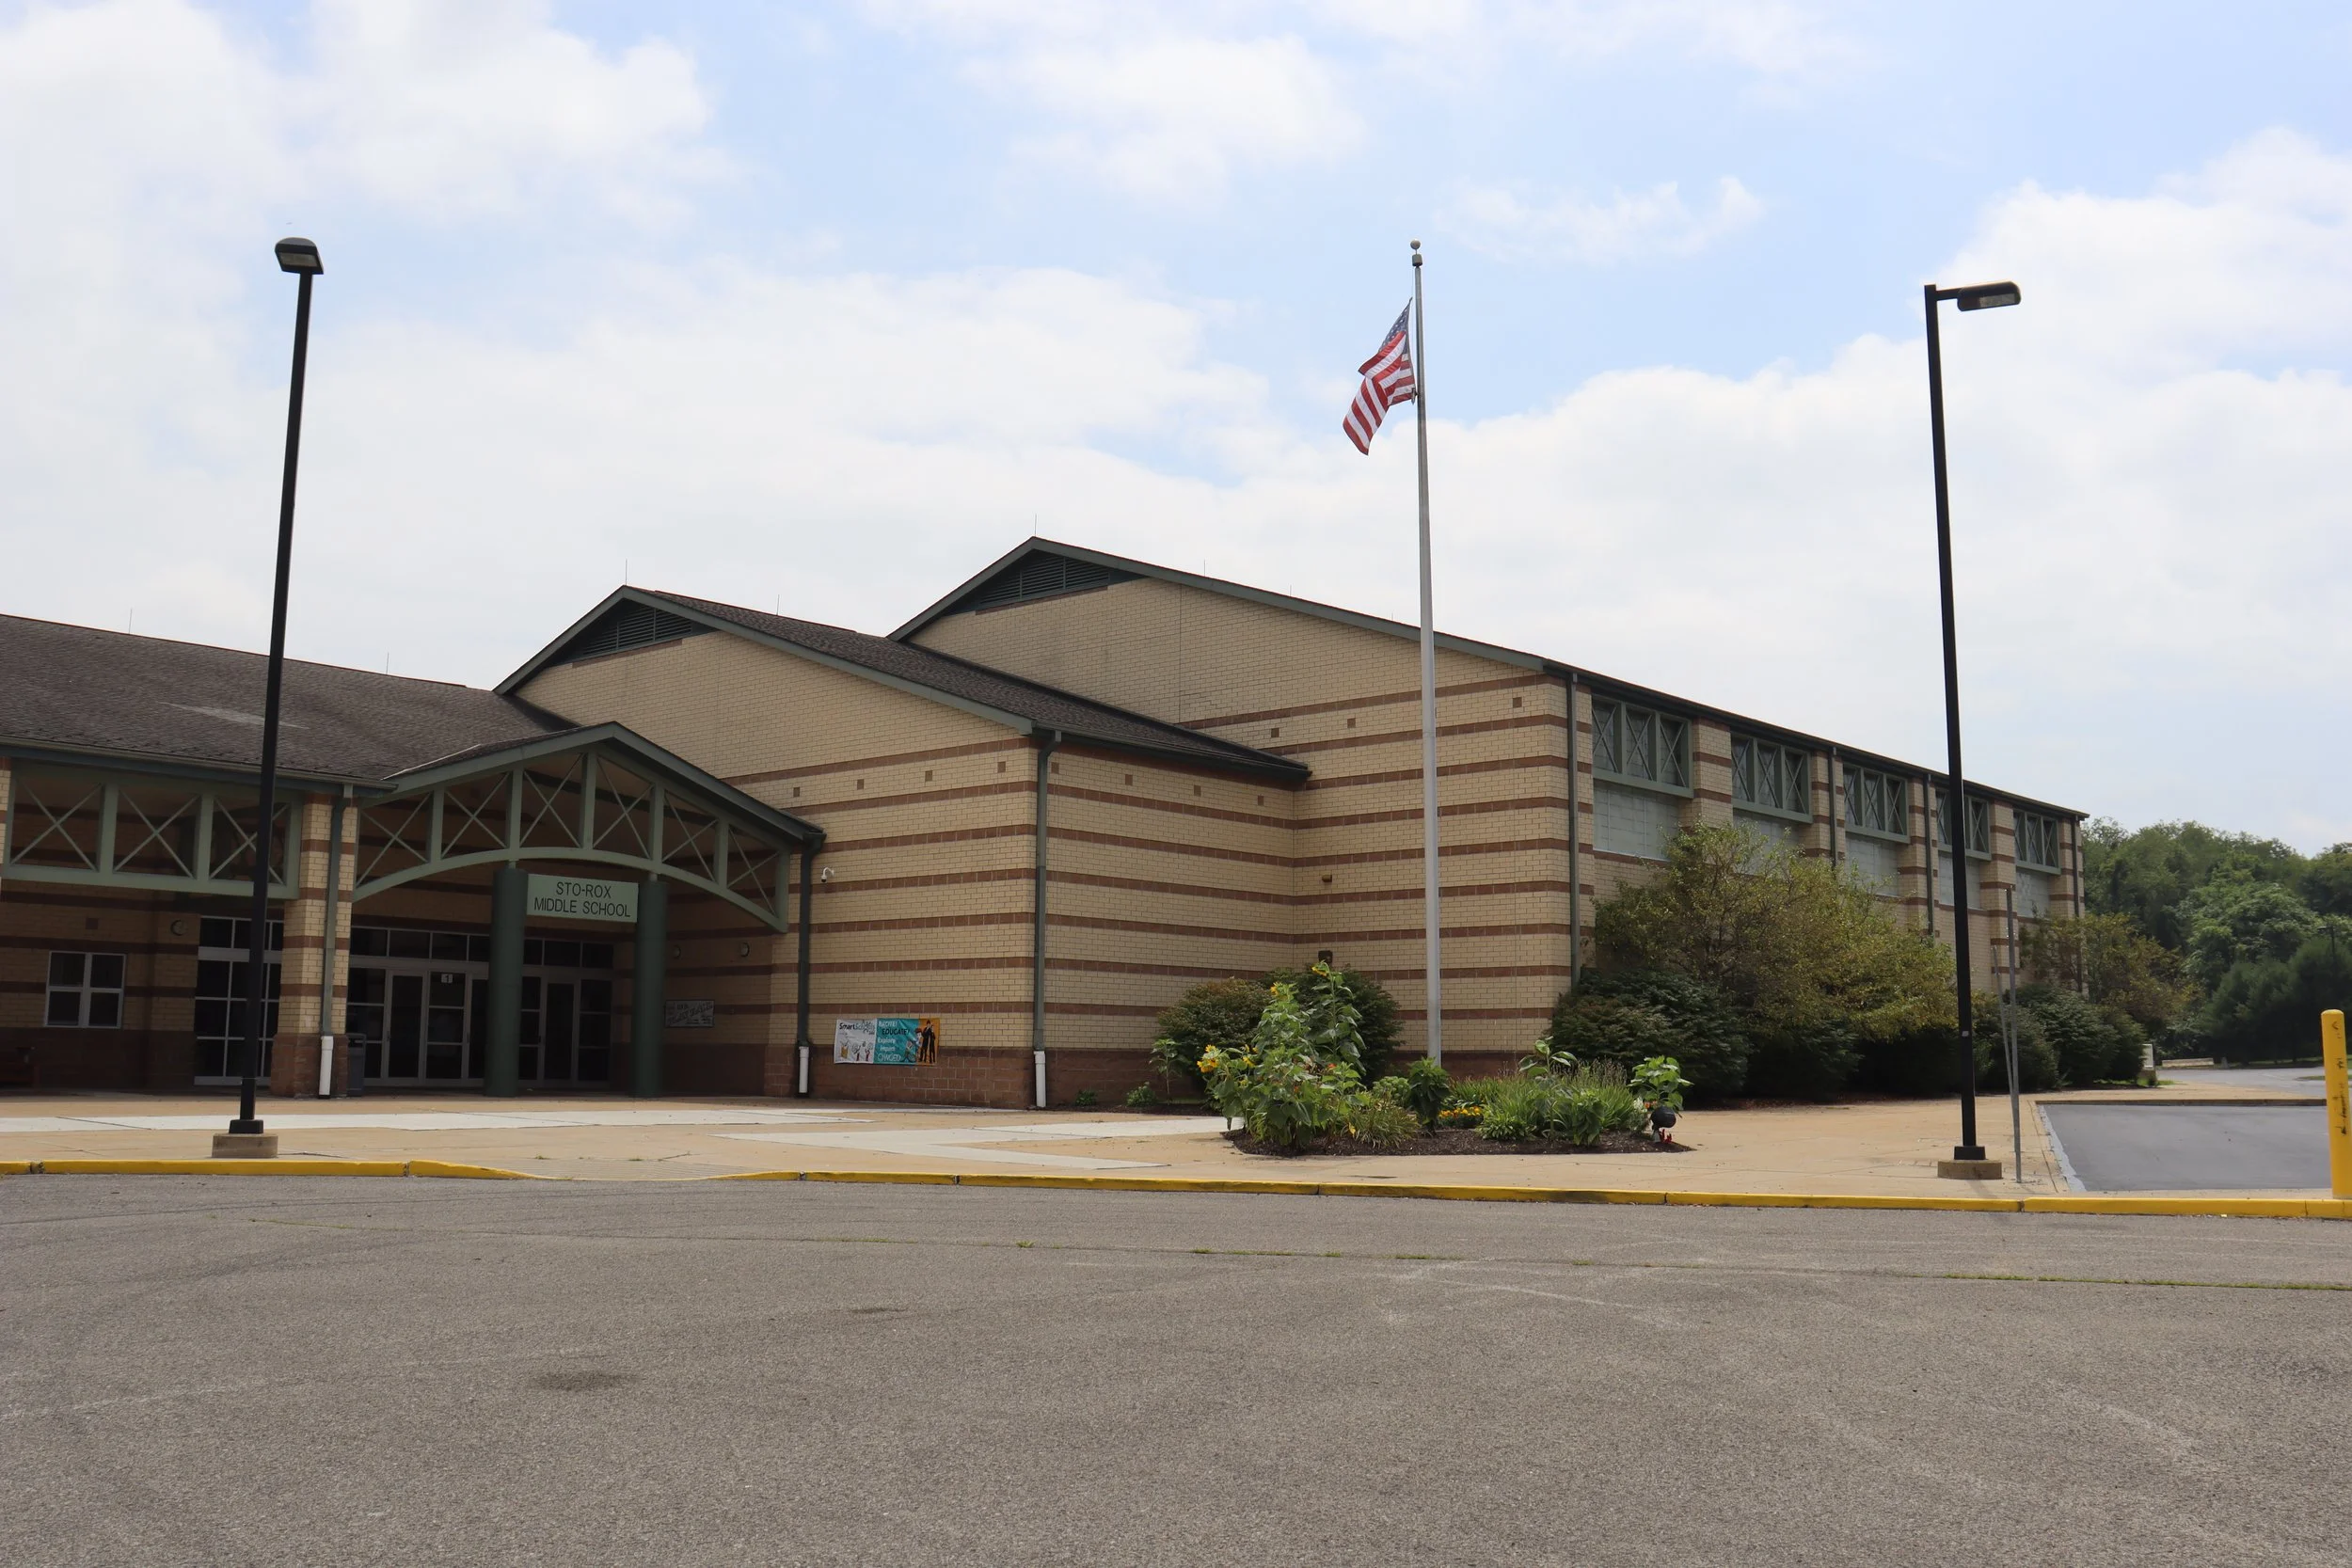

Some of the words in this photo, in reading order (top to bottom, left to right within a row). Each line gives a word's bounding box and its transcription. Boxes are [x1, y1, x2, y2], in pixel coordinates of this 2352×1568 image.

[556, 881, 612, 898] STO-ROX
[533, 897, 577, 913] MIDDLE
[582, 901, 630, 917] SCHOOL
